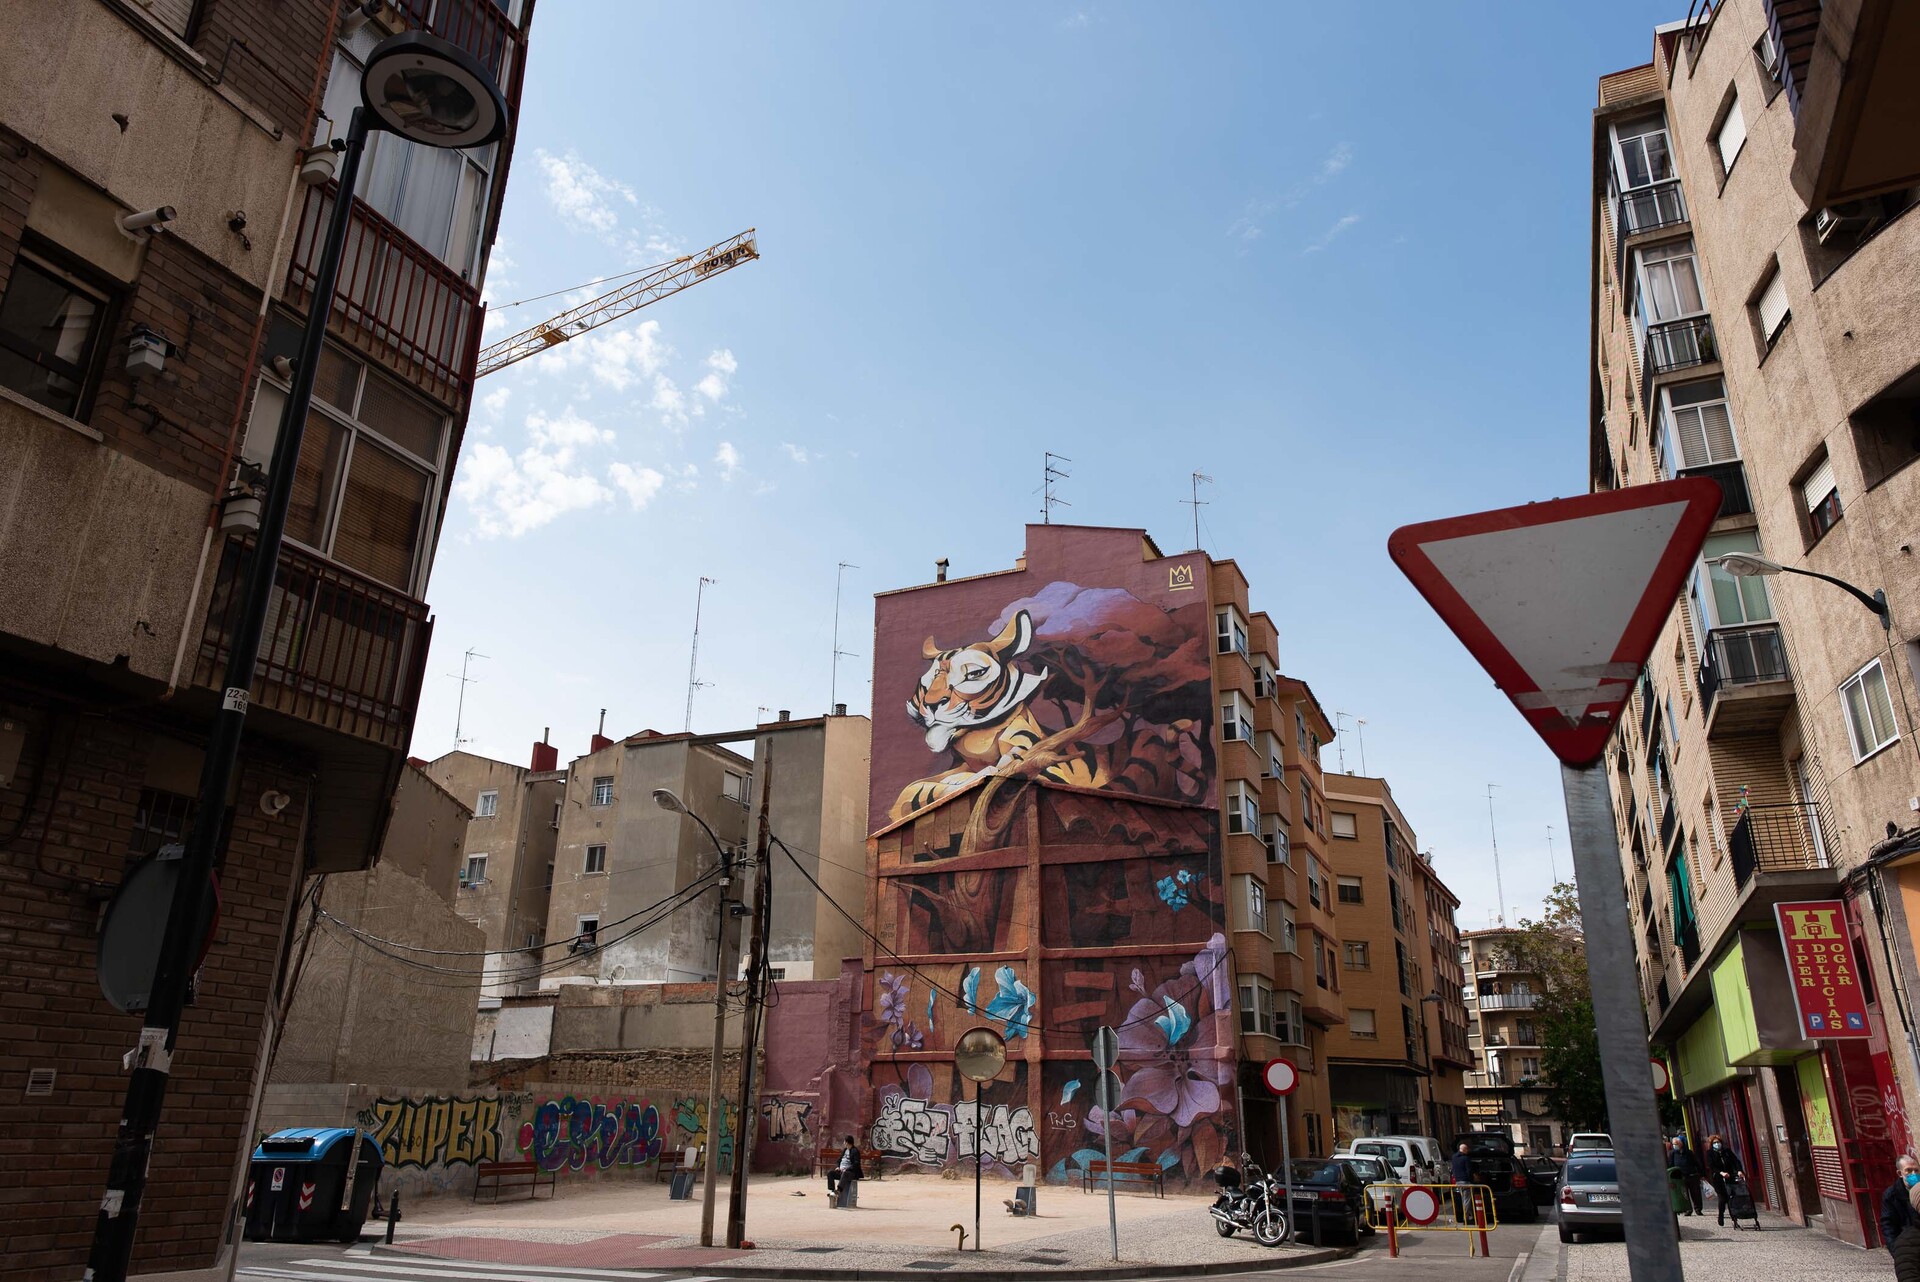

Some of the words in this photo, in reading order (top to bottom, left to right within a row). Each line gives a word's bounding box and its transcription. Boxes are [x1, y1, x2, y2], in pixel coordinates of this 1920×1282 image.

[1796, 944, 1816, 987] IPER
[1830, 943, 1853, 985] OGAR
[1811, 943, 1843, 1030] DELICIAS
[1811, 1016, 1821, 1027] P
[373, 1096, 502, 1171] ZUPER
